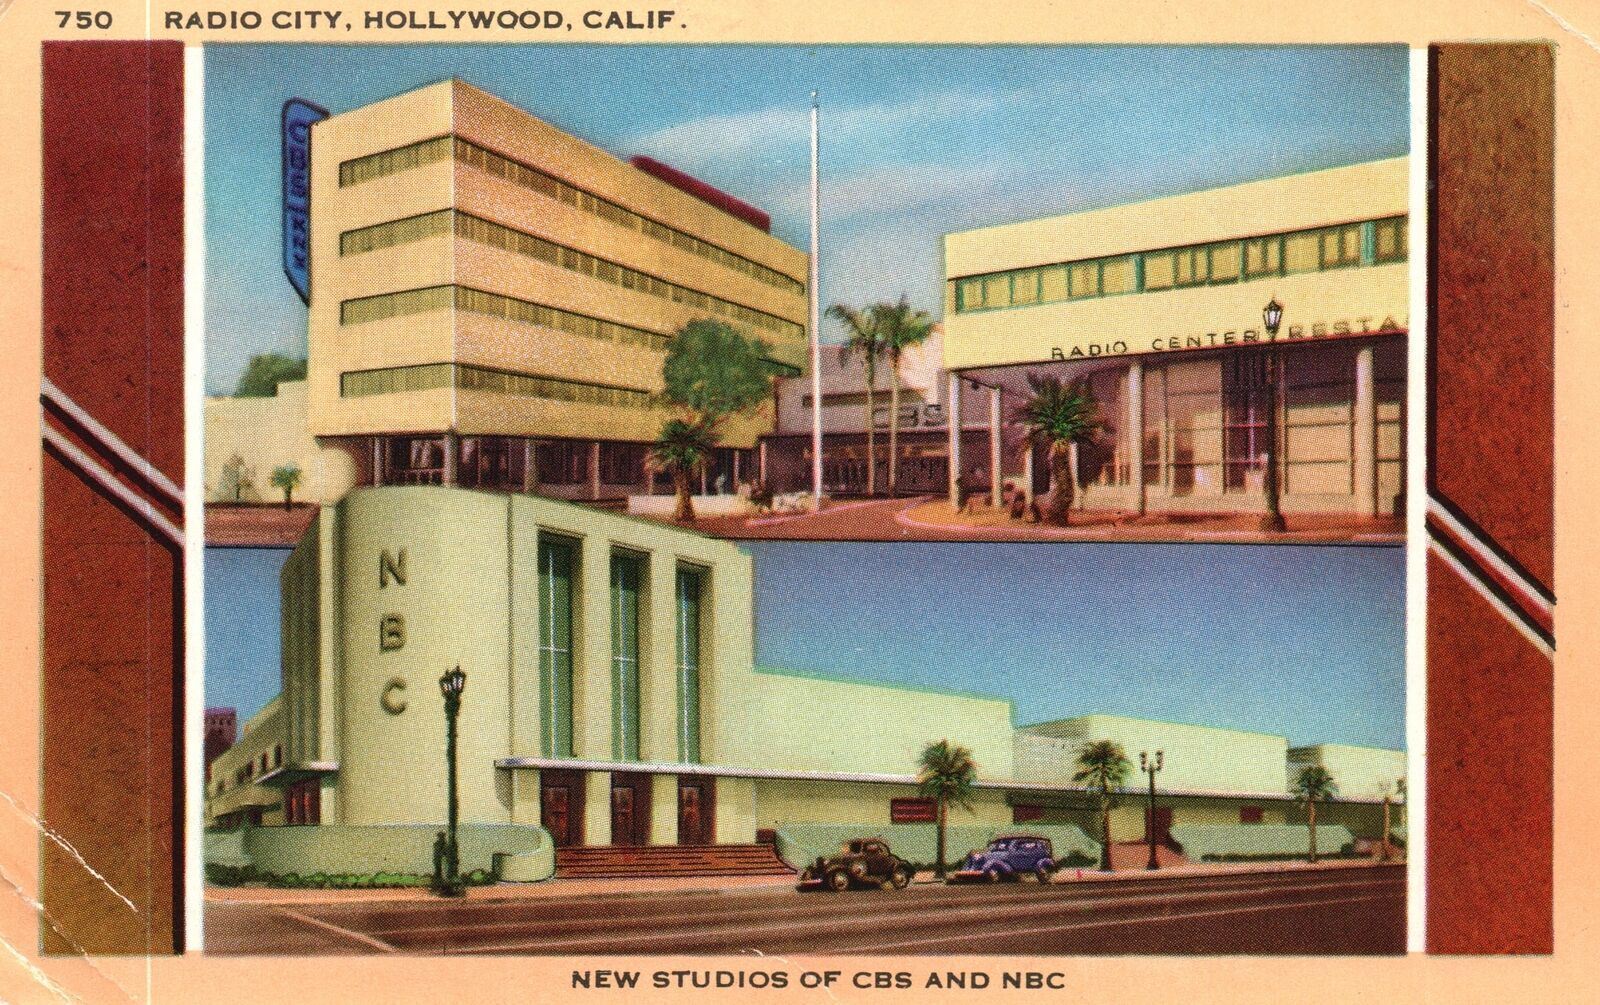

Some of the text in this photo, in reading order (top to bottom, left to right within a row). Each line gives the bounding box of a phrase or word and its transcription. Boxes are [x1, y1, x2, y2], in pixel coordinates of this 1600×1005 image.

[54, 10, 112, 29] 750
[164, 9, 687, 32] RADIO CITY, HOLLYWOOD, CALIF.
[1051, 341, 1128, 360] RADIO
[1151, 330, 1257, 351] CENTER
[872, 402, 946, 430] CBS
[379, 547, 407, 716] NBC
[571, 969, 1065, 989] NEW STUDIOS OF CBS AND NBC
